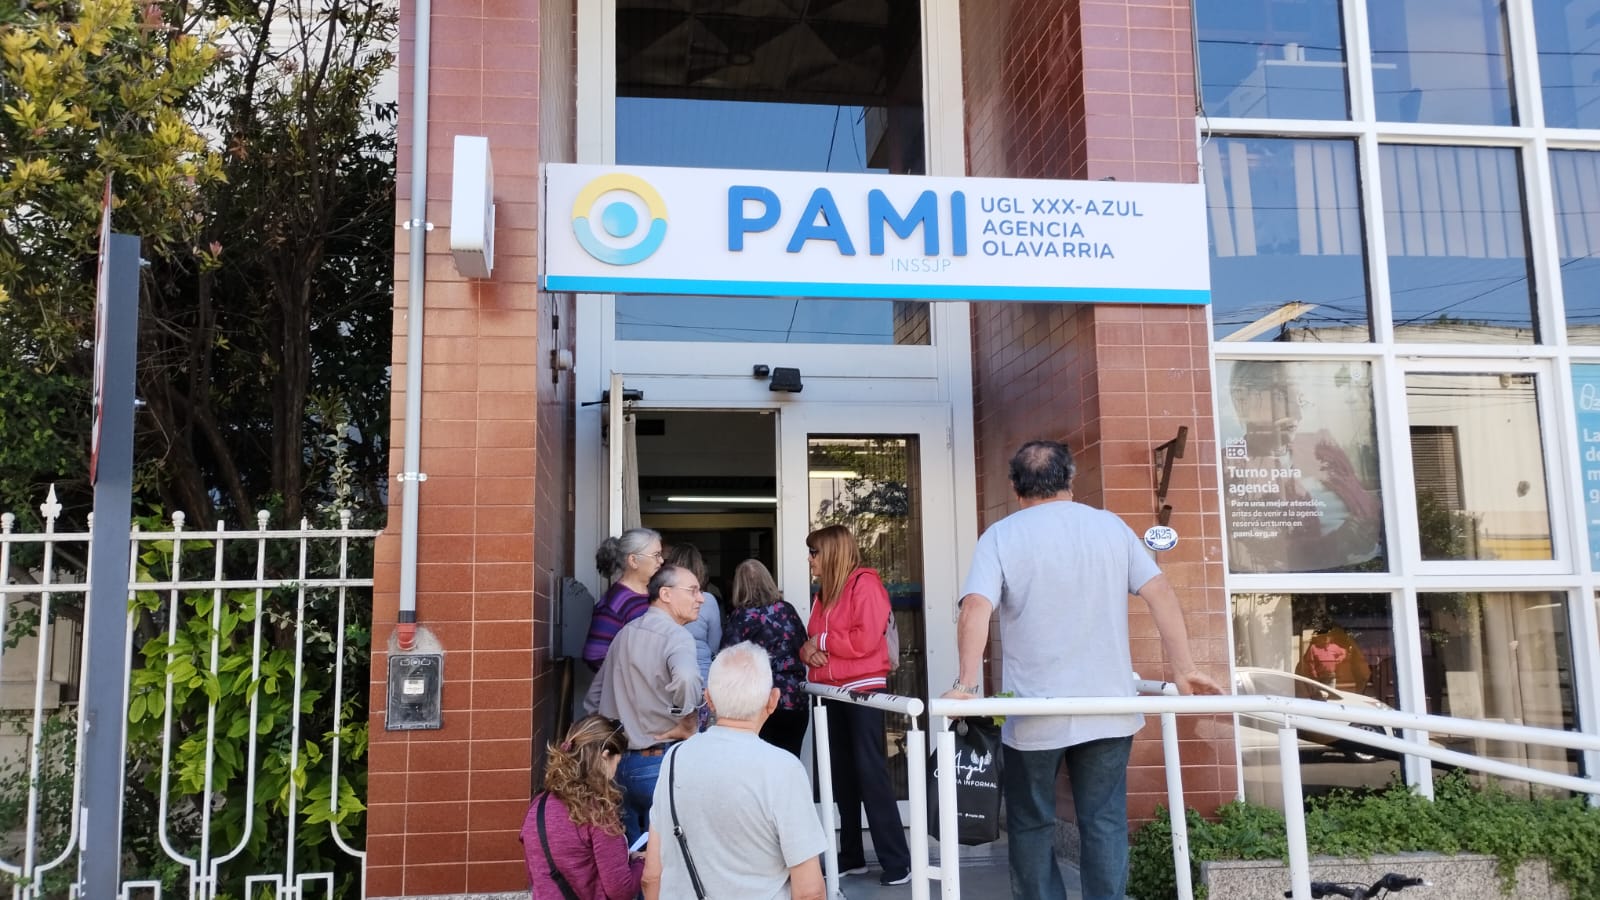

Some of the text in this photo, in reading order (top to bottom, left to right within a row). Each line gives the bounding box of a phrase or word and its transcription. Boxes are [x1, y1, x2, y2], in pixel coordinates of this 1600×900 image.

[981, 197, 1144, 217] UGL XXX-AZUL
[728, 185, 968, 257] PAMI
[983, 219, 1085, 238] AGENCIA
[982, 240, 1115, 259] OLAVARRIA
[891, 258, 952, 272] INSSJP
[1228, 466, 1301, 481] Turno para
[1229, 480, 1280, 496] agencia
[1266, 500, 1288, 508] mejor
[1253, 509, 1262, 517] de
[1288, 509, 1295, 517] la
[1296, 509, 1324, 518] agencia
[1149, 528, 1172, 540] 2625
[964, 780, 998, 789] INFORMAL
